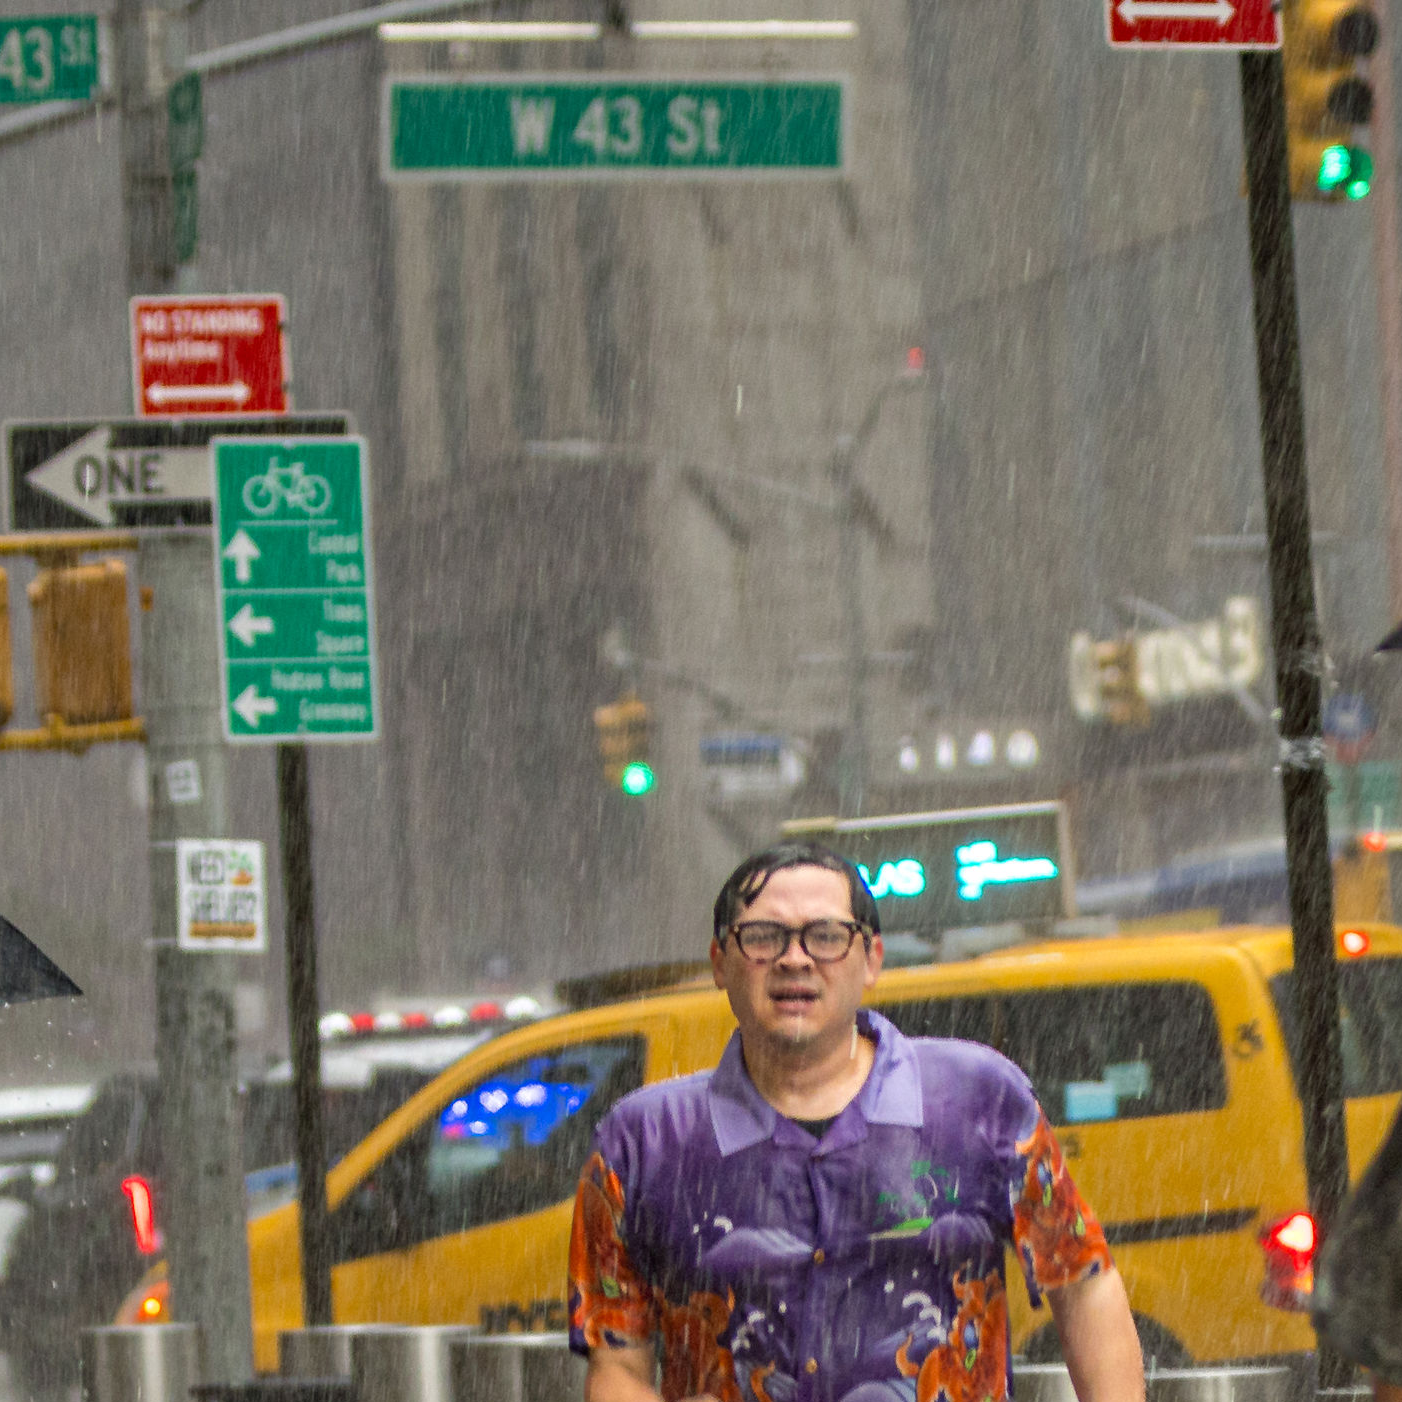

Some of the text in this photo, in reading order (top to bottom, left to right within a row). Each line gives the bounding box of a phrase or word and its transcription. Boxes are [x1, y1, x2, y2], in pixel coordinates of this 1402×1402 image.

[509, 94, 722, 156] W 43 St
[141, 309, 262, 333] NO STANDING
[145, 339, 219, 367] Anytime
[73, 453, 164, 498] ONE
[326, 559, 362, 582] Park
